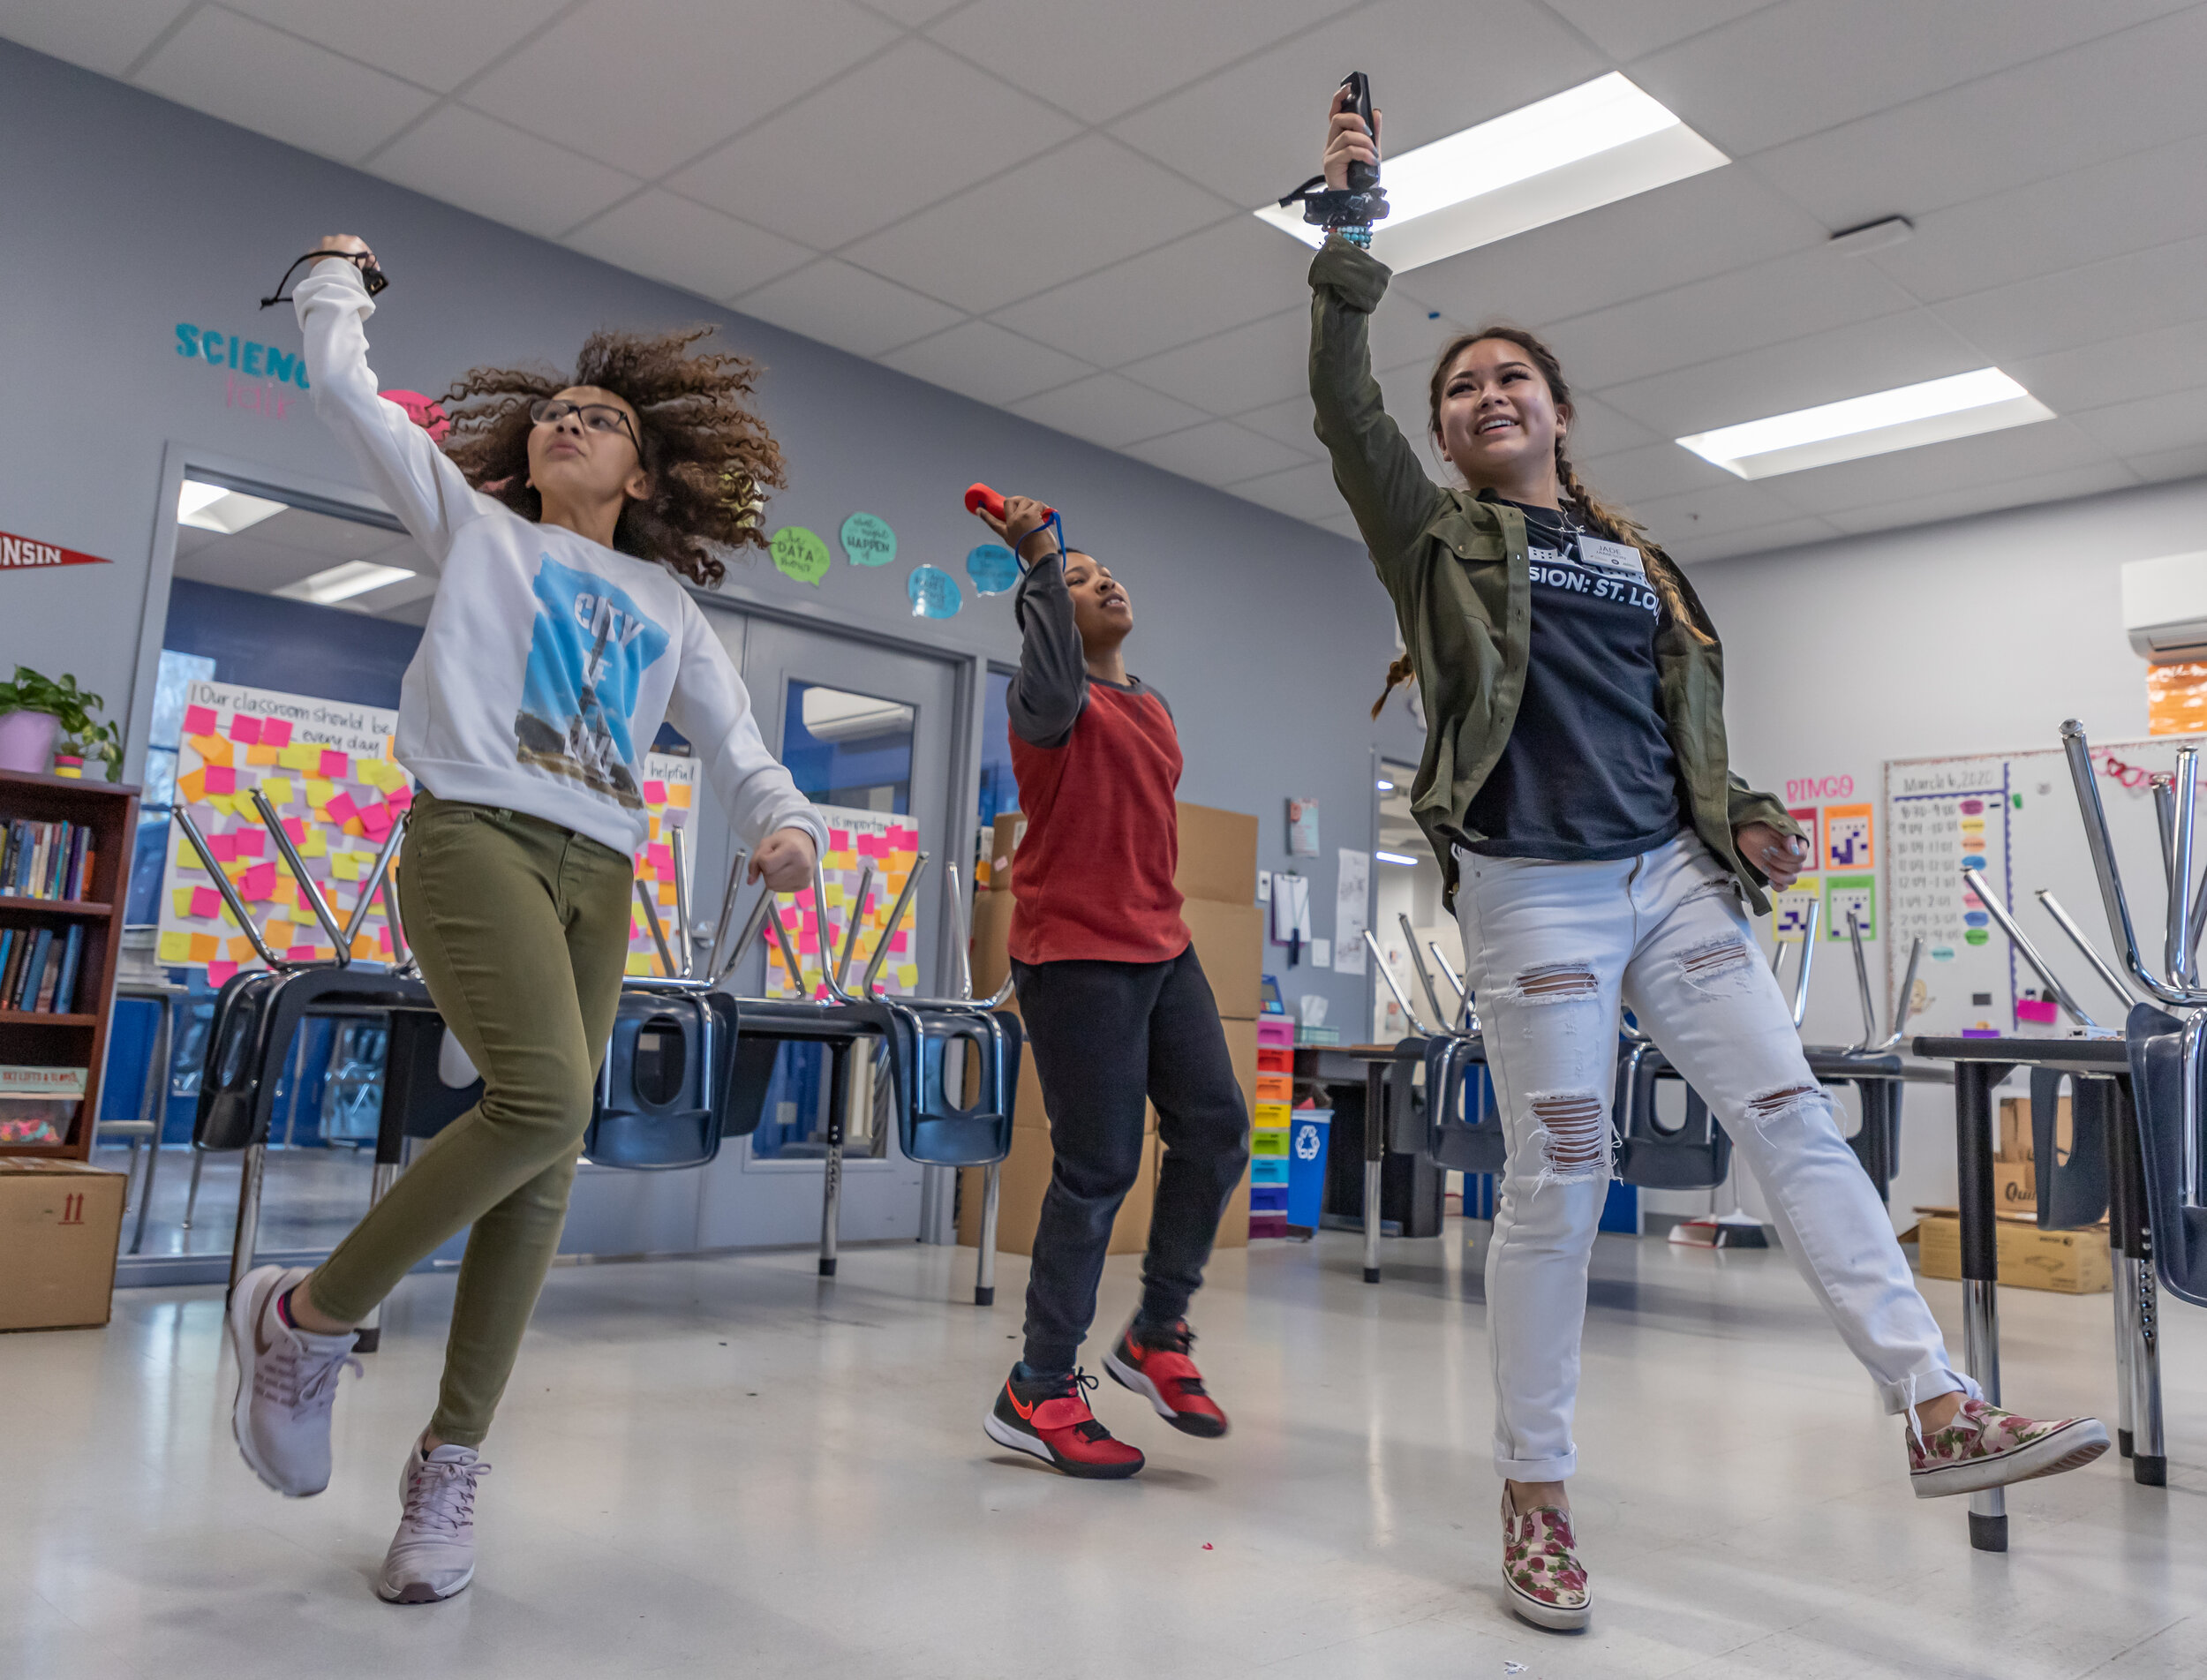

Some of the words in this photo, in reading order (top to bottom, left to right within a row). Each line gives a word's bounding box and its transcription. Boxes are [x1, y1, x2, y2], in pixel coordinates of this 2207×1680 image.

[0, 535, 62, 566] NSIN
[777, 541, 814, 562] DATA
[847, 536, 890, 553] HAPPEN
[1599, 545, 1623, 556] JADE
[1593, 578, 1625, 601] ST.
[574, 591, 646, 648] CITY
[200, 684, 230, 706] Our
[232, 690, 310, 719] classroom
[313, 709, 364, 731] should
[372, 716, 392, 735] be
[302, 729, 343, 750] every
[346, 733, 380, 757] day
[650, 760, 695, 782] helpful
[1786, 774, 1855, 804] BINGO
[831, 814, 840, 827] is
